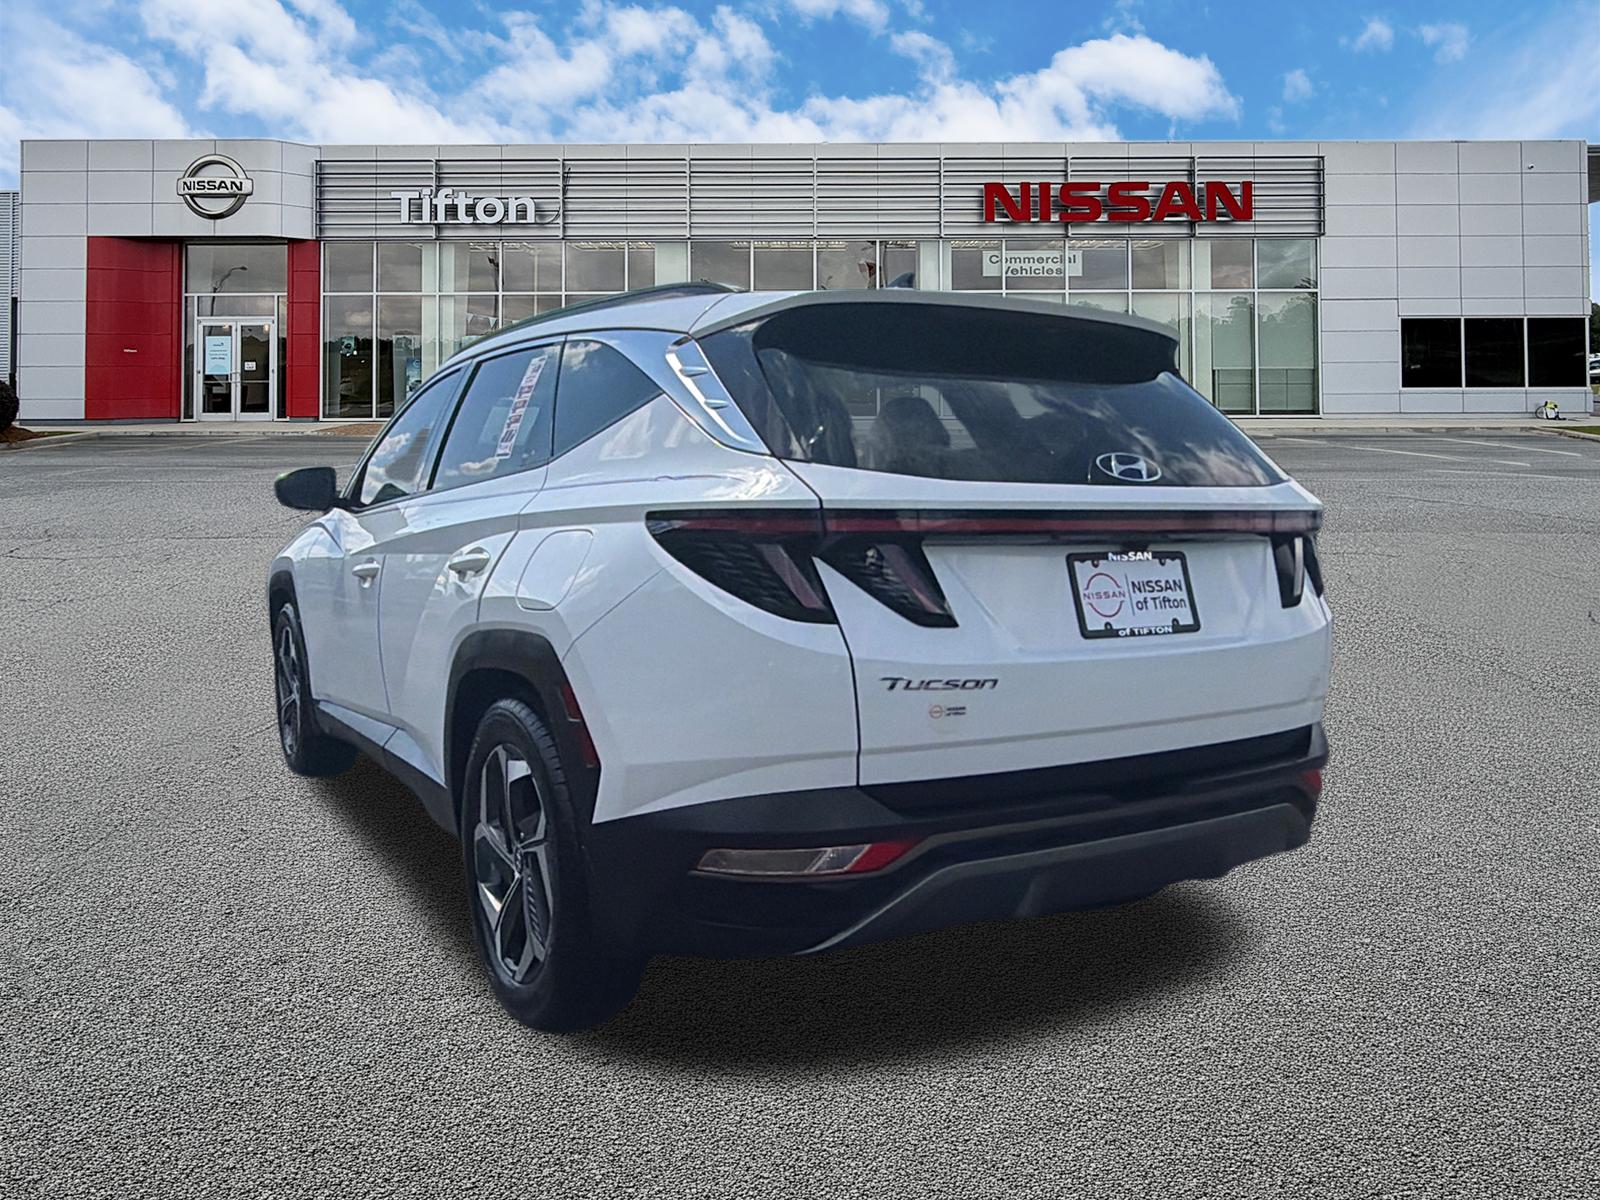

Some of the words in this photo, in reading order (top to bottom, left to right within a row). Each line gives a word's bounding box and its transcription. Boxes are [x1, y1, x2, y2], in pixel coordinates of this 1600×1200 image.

[183, 181, 243, 191] NISSAN
[391, 188, 536, 224] Tifton
[984, 181, 1253, 222] NISSAN
[1108, 552, 1152, 561] NISSAN
[1131, 579, 1183, 594] NISSAN
[1083, 590, 1126, 601] NISSAN
[1135, 597, 1150, 611] of
[1151, 596, 1187, 610] Tifton
[1118, 628, 1132, 637] of
[1134, 625, 1173, 636] TIFTON
